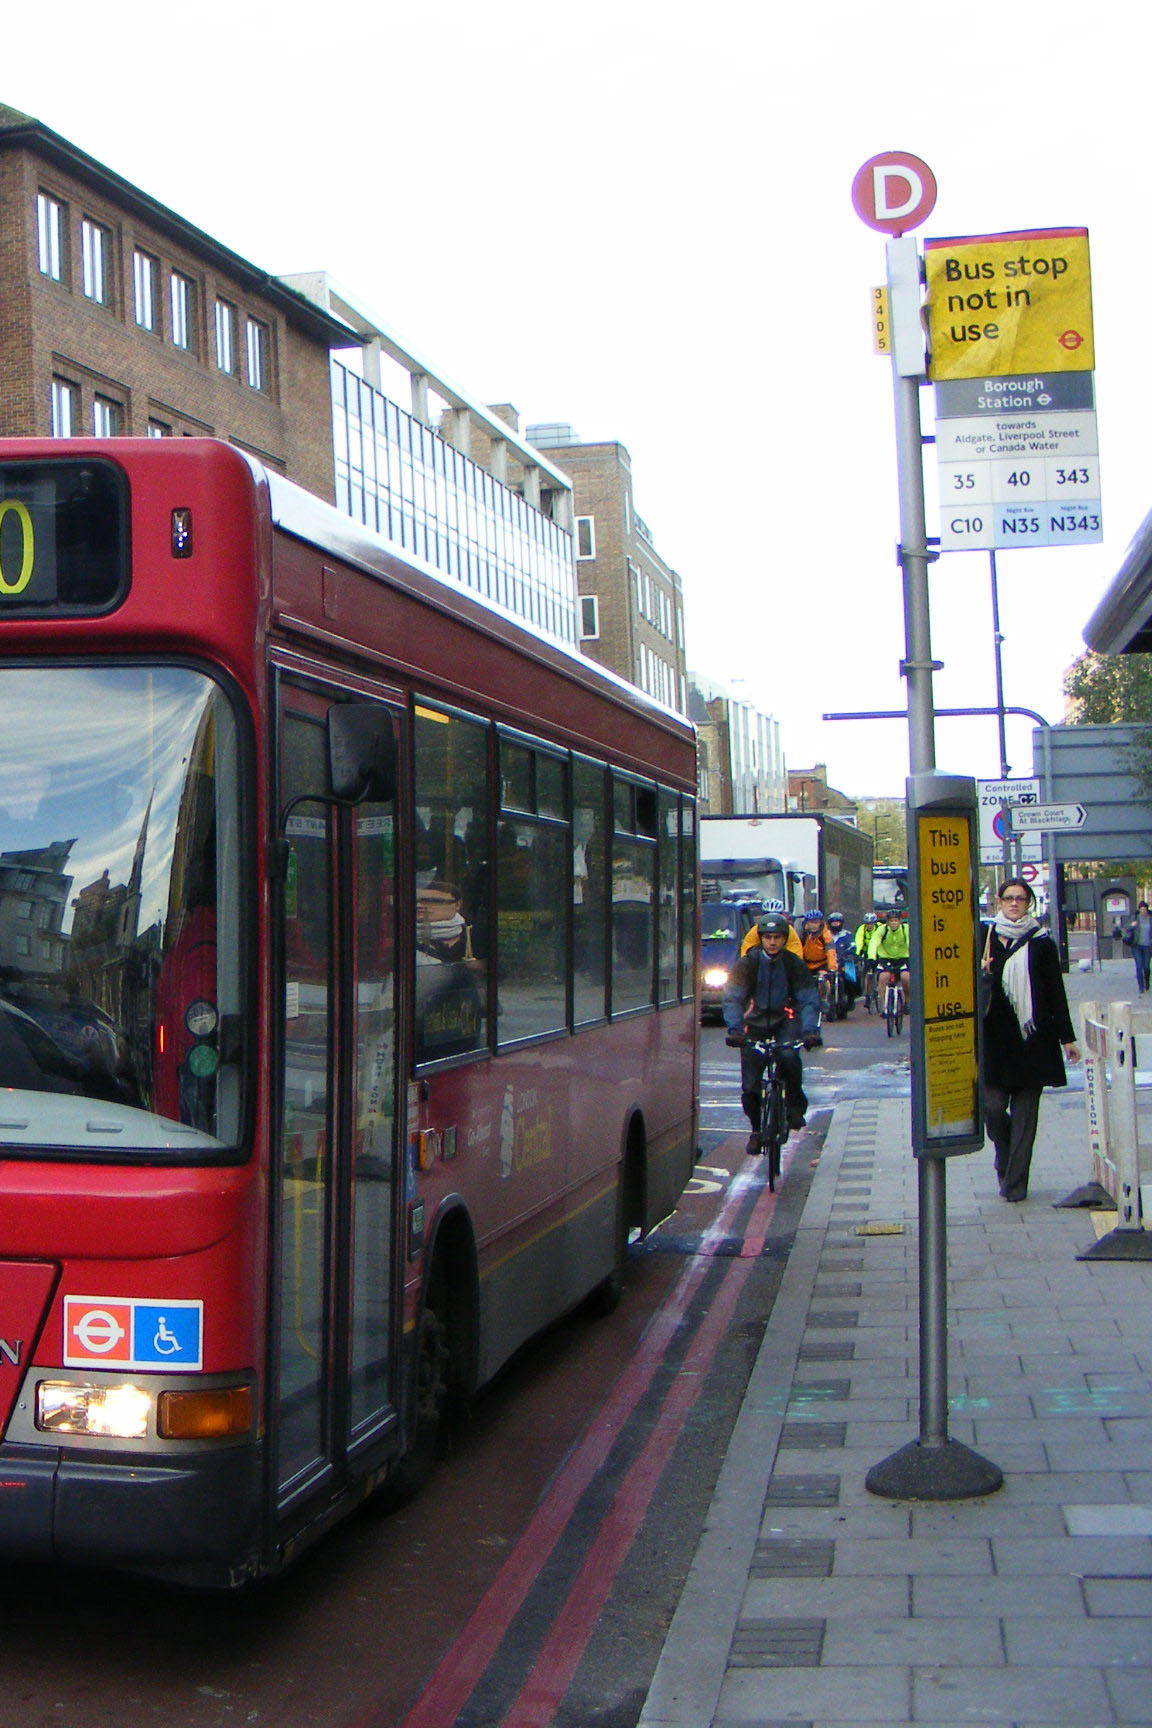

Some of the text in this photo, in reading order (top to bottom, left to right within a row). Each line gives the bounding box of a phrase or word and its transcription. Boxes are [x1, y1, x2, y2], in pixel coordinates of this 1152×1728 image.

[873, 165, 923, 220] D
[945, 256, 1068, 282] Bus stop
[948, 286, 1031, 312] not in
[875, 289, 886, 349] 3405
[950, 322, 1000, 343] use
[984, 378, 1044, 393] Borough
[977, 395, 1032, 409] Station
[996, 421, 1037, 430] towards
[998, 431, 1045, 442] Liverpool
[1048, 429, 1080, 438] Street
[989, 444, 1026, 453] Canada
[1029, 442, 1060, 450] Water
[953, 474, 975, 489] 35
[1007, 471, 1030, 487] 40
[1056, 468, 1089, 485] 343
[950, 517, 983, 534] C10
[1002, 517, 1040, 534] N35
[1050, 515, 1099, 532] N343
[985, 784, 1033, 792] Controlled
[929, 829, 959, 847] This
[931, 858, 957, 875] bus
[931, 887, 963, 906] stop
[933, 915, 945, 932] is
[935, 943, 960, 960] not
[936, 971, 949, 988] in
[937, 1001, 966, 1017] use.
[1087, 1068, 1097, 1126] MORRISON
